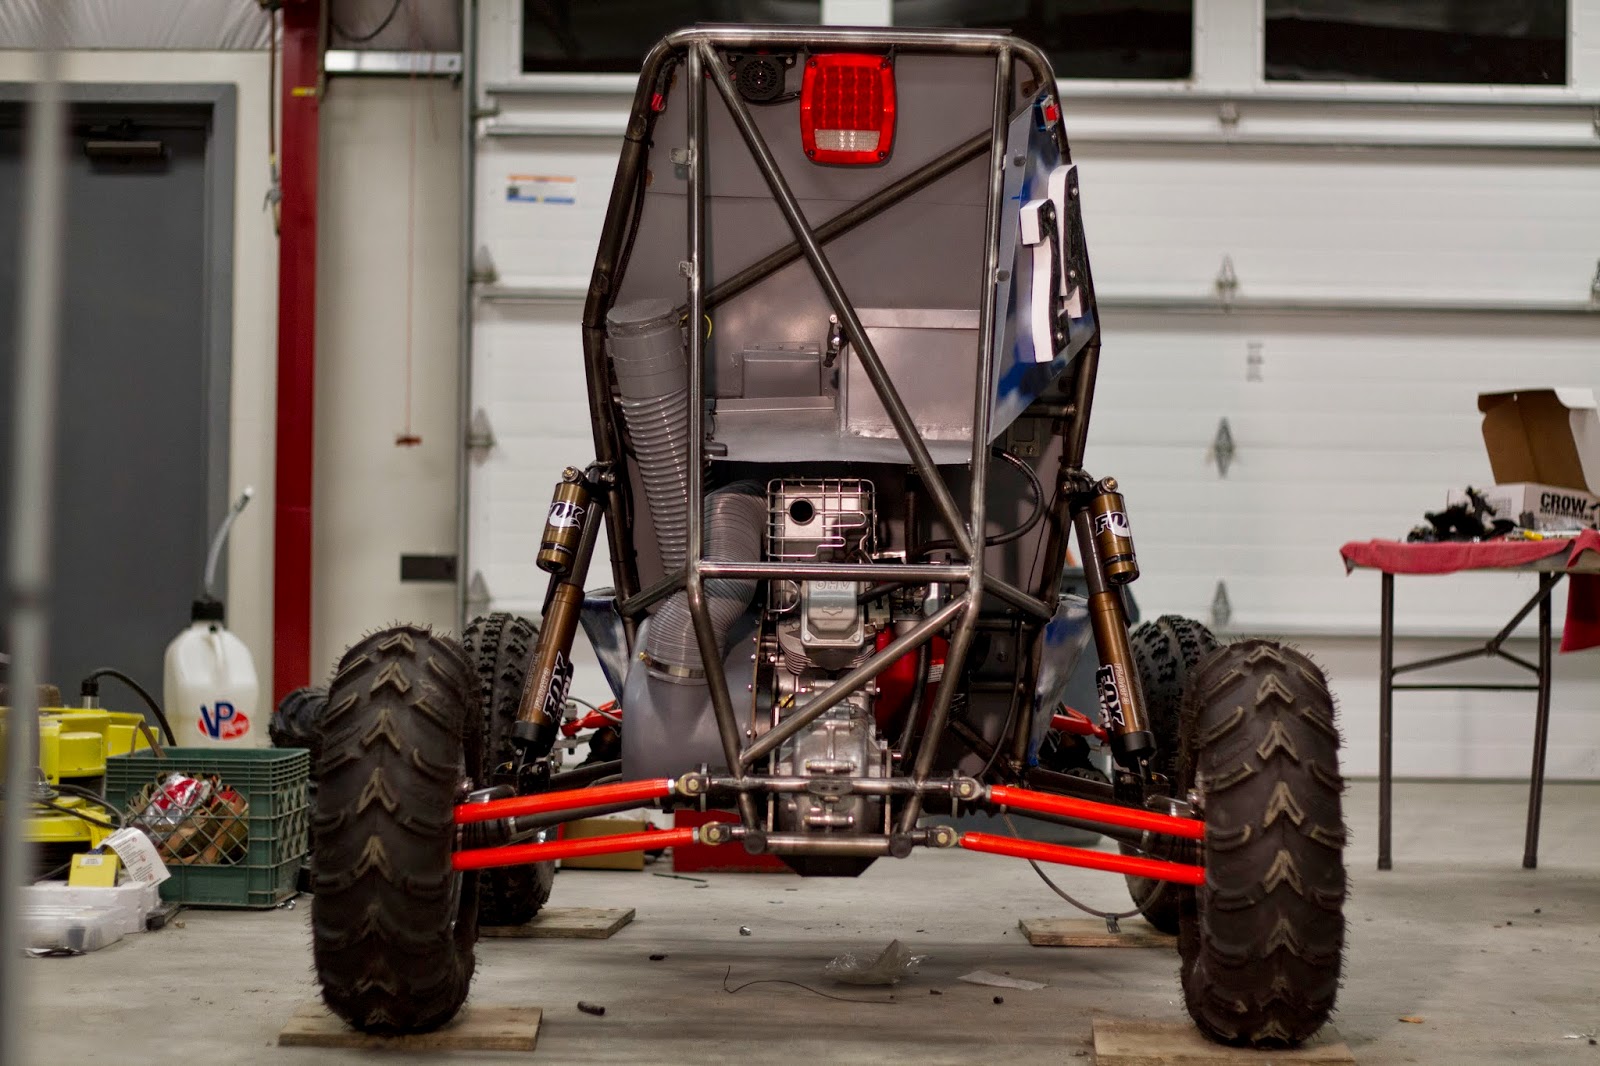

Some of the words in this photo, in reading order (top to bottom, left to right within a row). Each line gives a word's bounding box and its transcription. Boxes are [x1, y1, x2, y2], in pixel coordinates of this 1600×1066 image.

[549, 501, 585, 530] OX
[1540, 491, 1588, 514] CROW
[543, 651, 567, 722] FOX
[1099, 664, 1126, 728] FOX
[200, 702, 235, 739] VP
